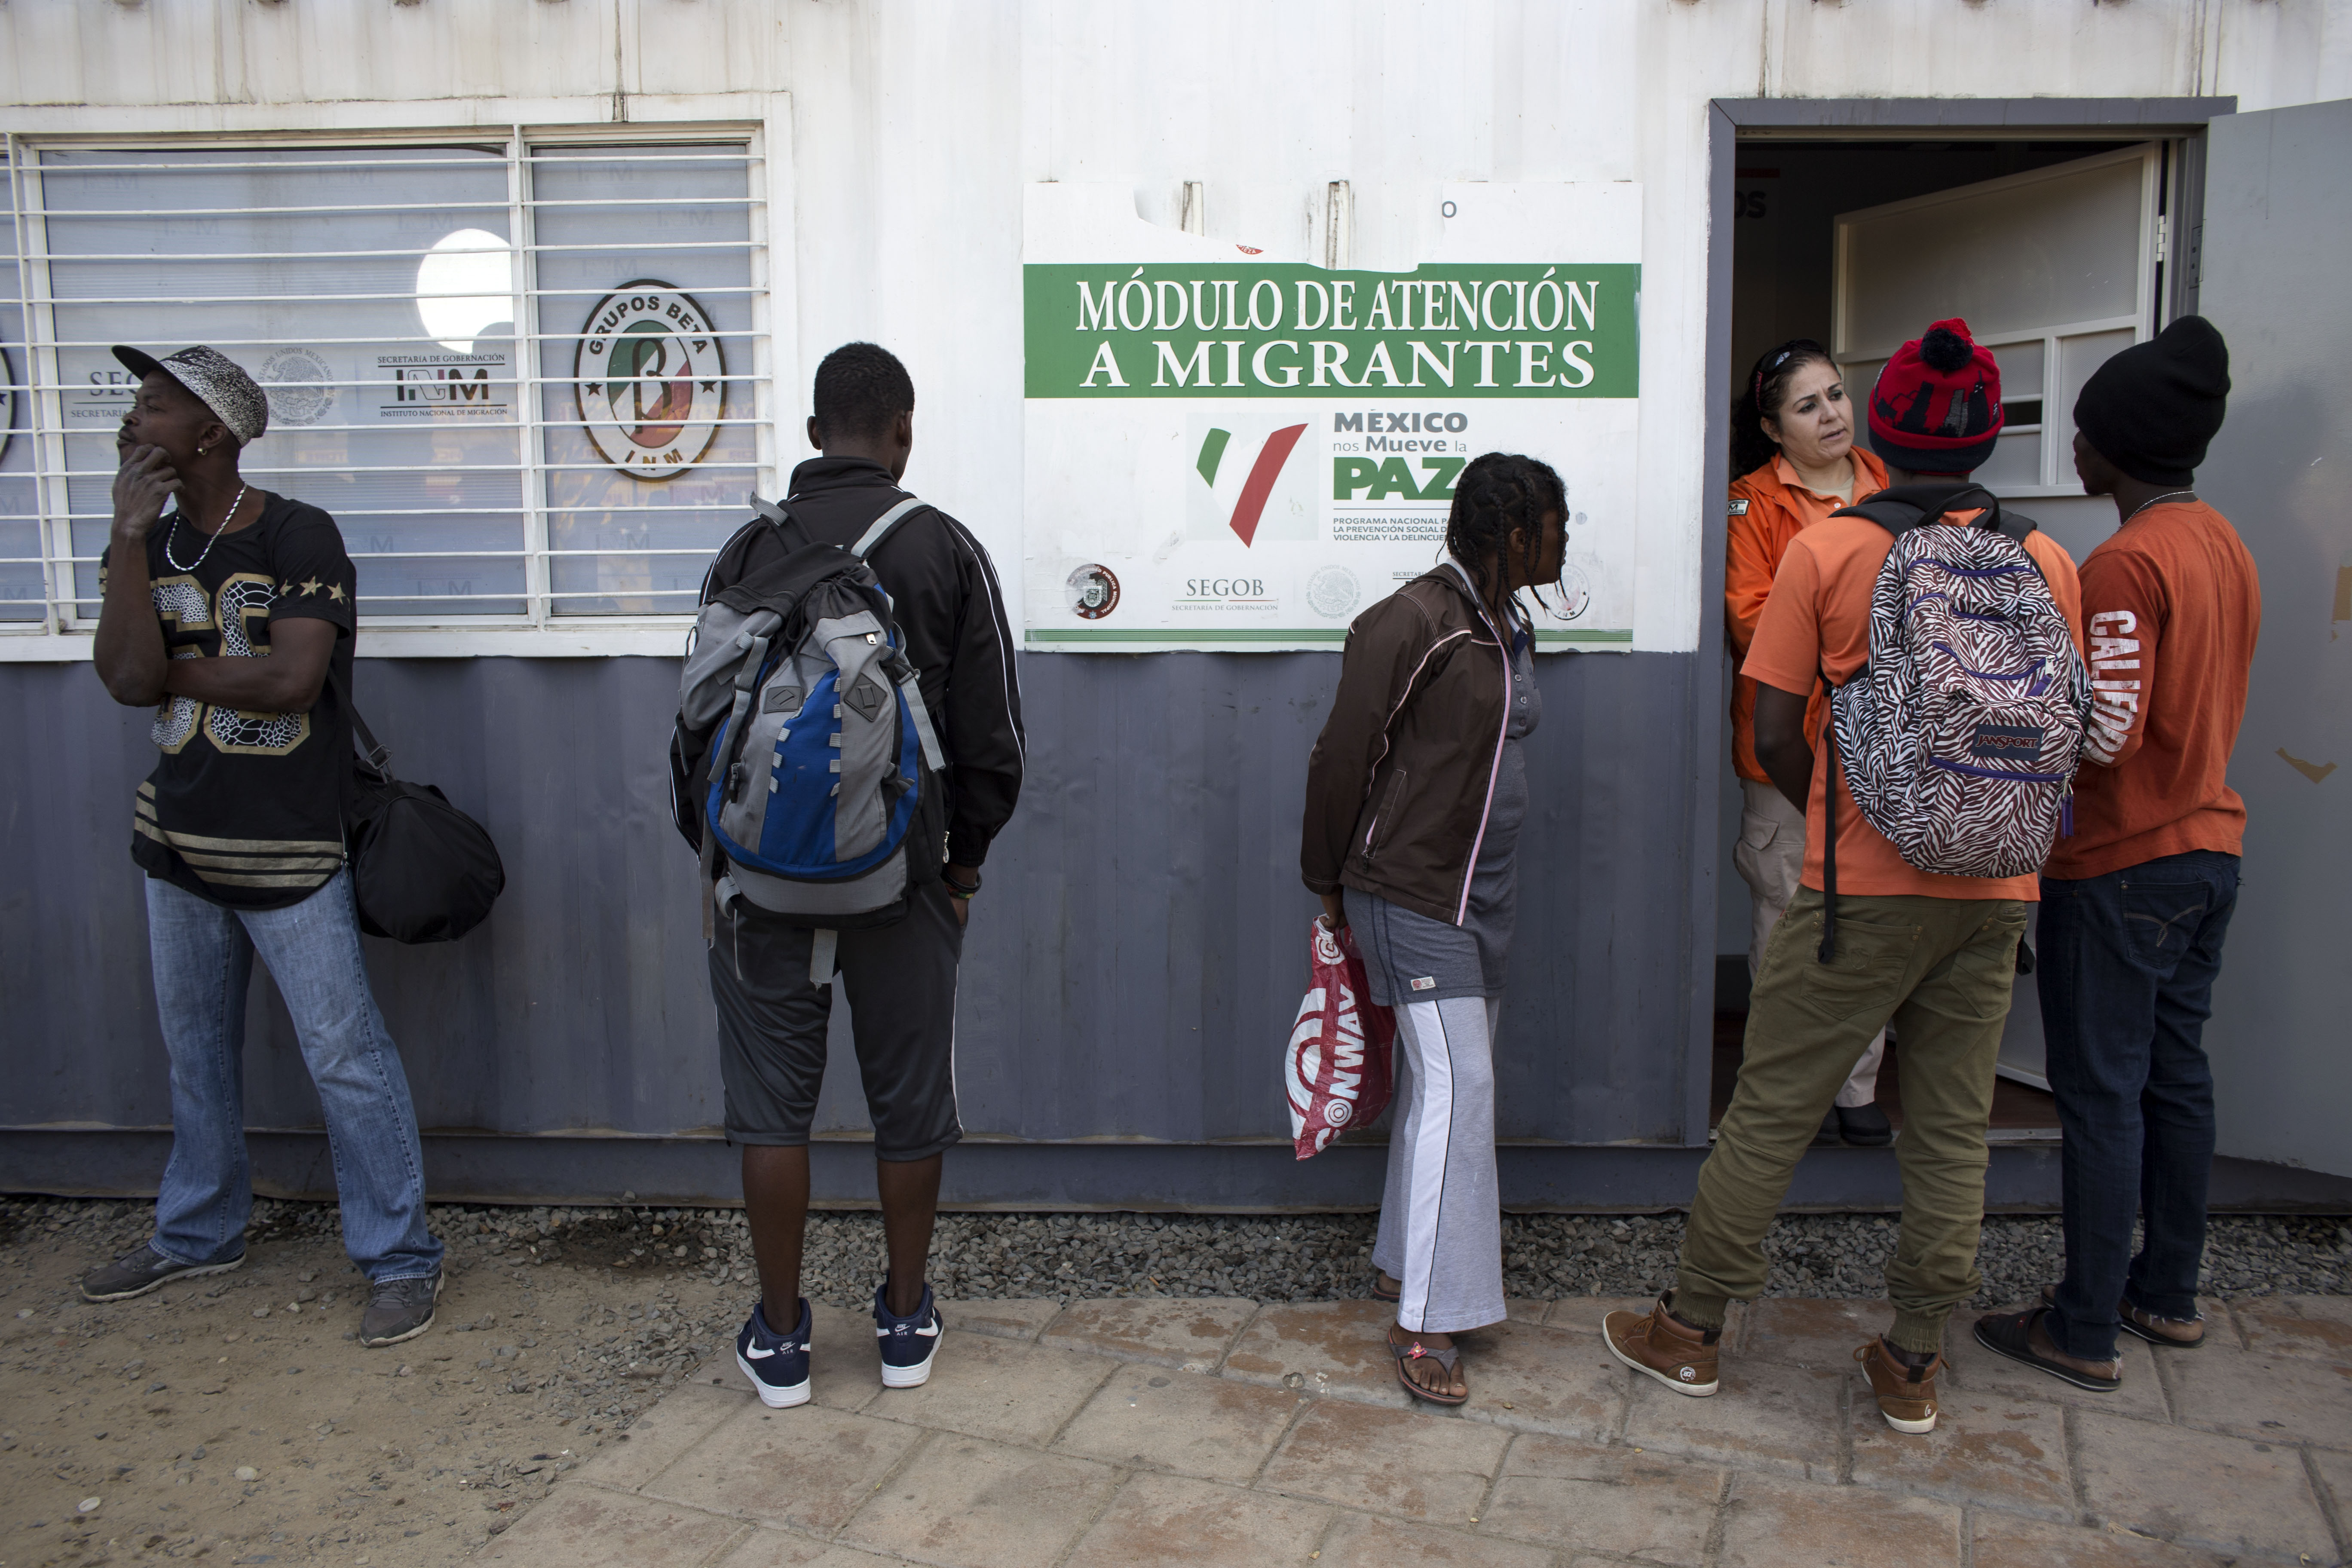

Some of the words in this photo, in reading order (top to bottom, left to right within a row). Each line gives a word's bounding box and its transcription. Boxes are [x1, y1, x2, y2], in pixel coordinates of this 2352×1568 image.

[1076, 266, 1283, 331] MÓDULO
[1294, 281, 1357, 331] DE
[1364, 266, 1600, 331] ATENCIÓN
[589, 296, 660, 355] GRUPOS
[666, 302, 708, 355] BETA
[377, 355, 427, 363] SECRETARÍA
[443, 353, 505, 362] GOBERNACIÓN
[1079, 340, 1130, 387] A
[1151, 340, 1595, 388] MIGRANTES
[1333, 443, 1359, 452] nos
[1366, 435, 1447, 452] Mueve
[1455, 440, 1467, 452] la
[1333, 457, 1467, 500] PAZ
[1346, 524, 1404, 533] PREVENCIÓN
[1102, 571, 1117, 590] PUBLICA
[1186, 579, 1264, 596] SEGOB
[1100, 591, 1117, 614] MUNICIPAL
[1975, 734, 2039, 749] JANSPORT
